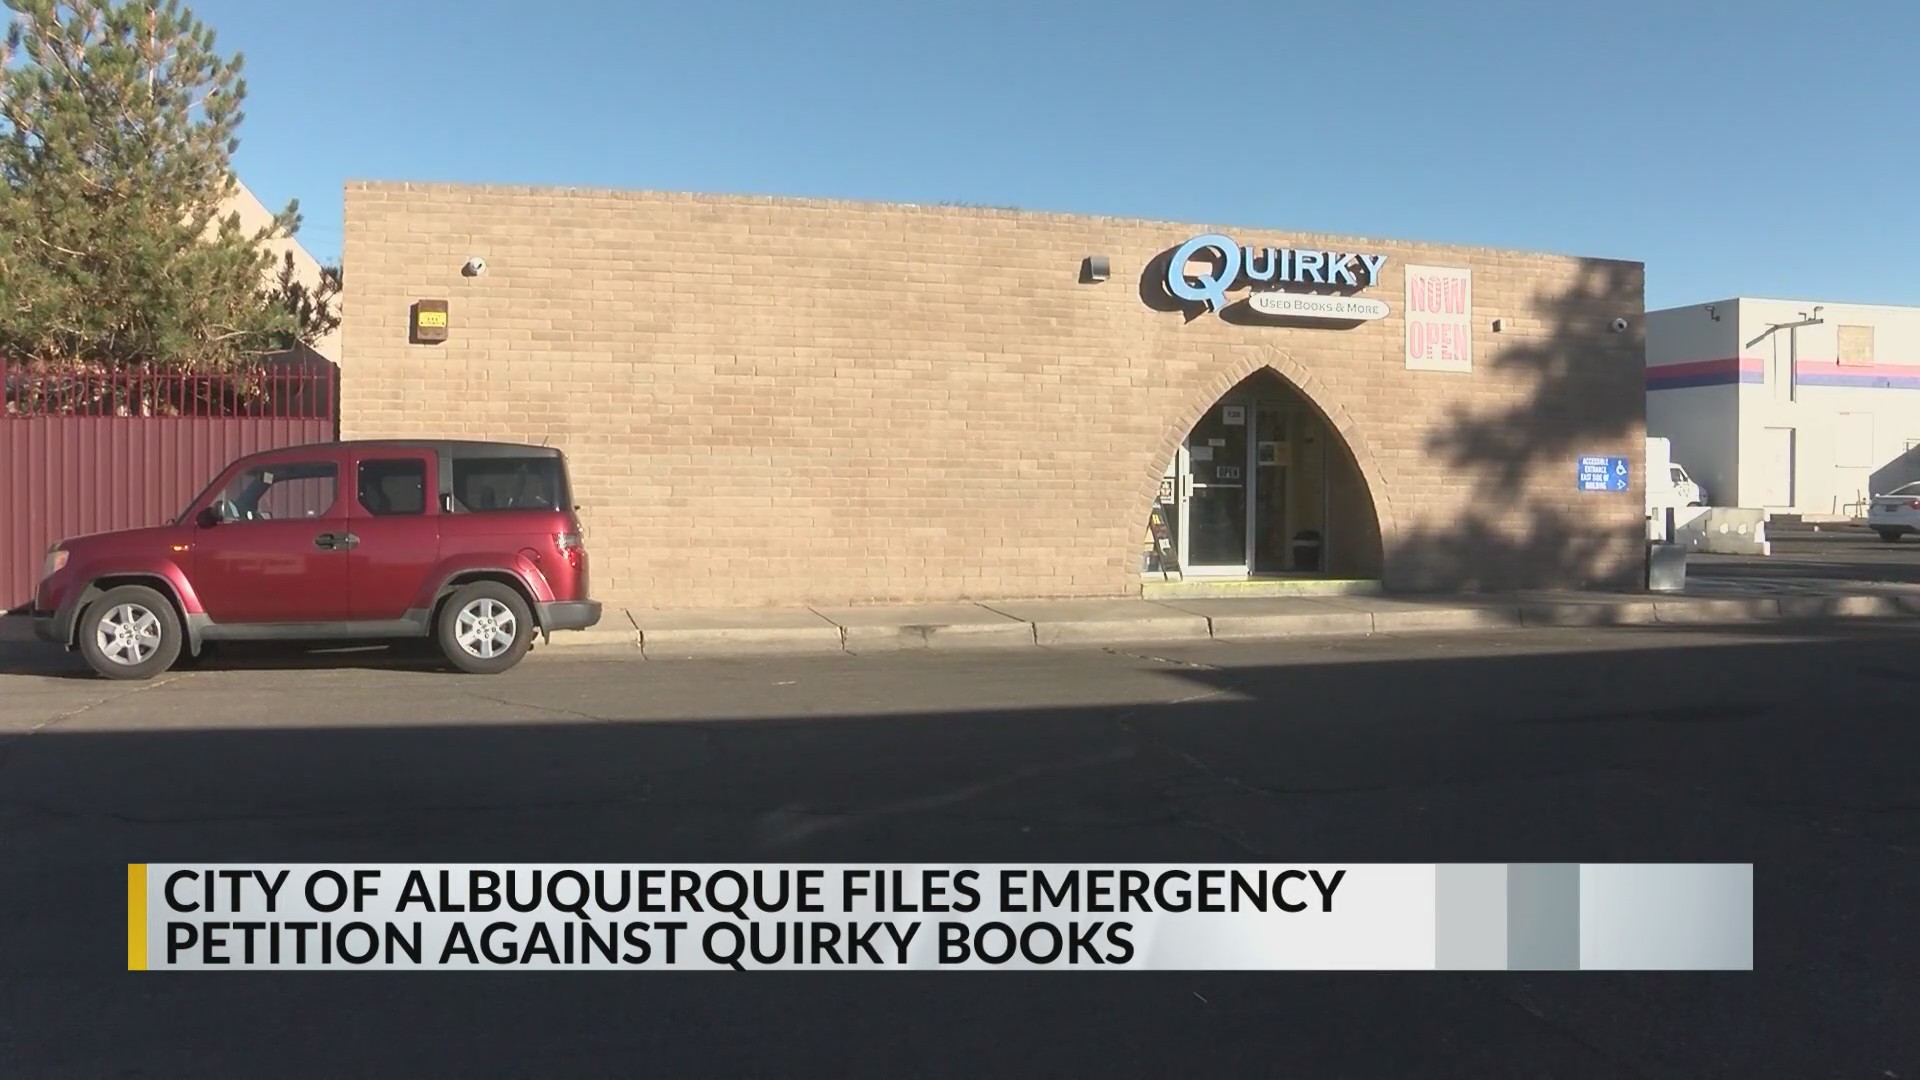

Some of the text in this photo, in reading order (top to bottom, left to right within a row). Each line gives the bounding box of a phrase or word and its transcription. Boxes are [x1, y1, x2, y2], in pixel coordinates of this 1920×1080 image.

[1168, 233, 1388, 312] QUIRKY
[1260, 298, 1379, 314] USED BOOKS & MORE
[1411, 274, 1466, 314] NOW
[1410, 320, 1467, 361] OPEN
